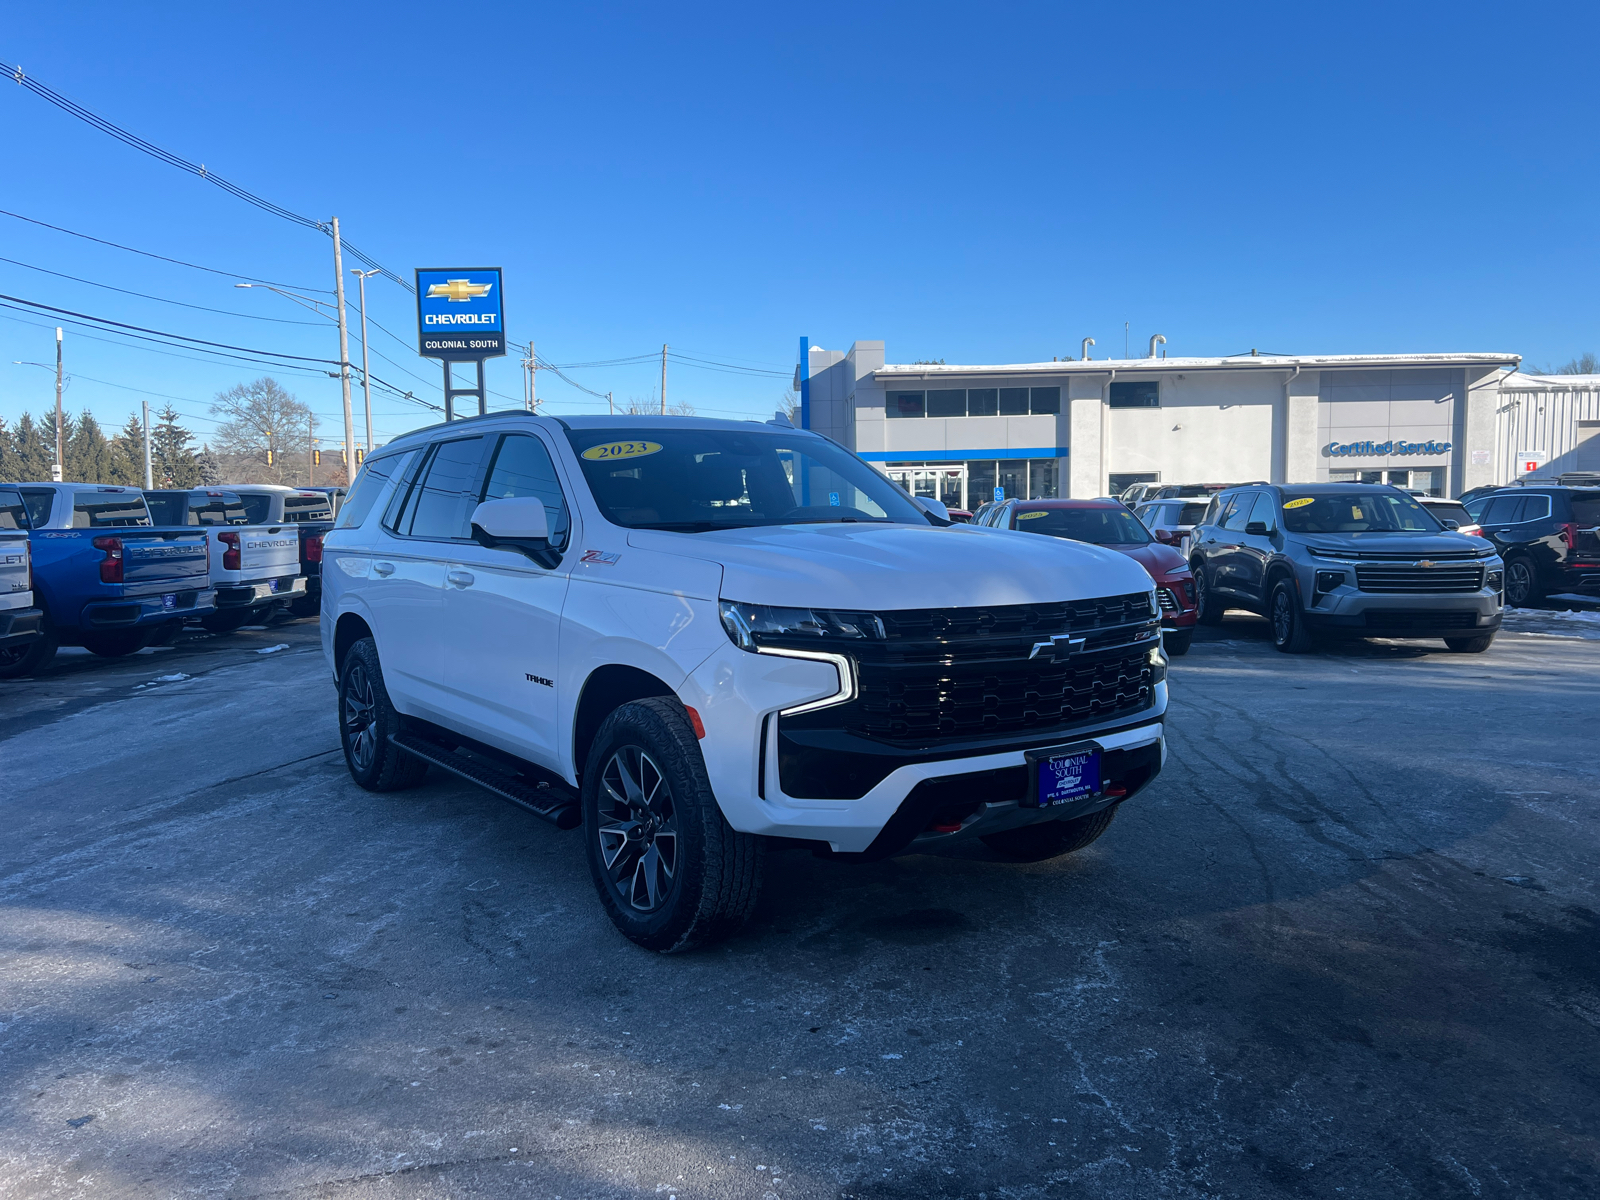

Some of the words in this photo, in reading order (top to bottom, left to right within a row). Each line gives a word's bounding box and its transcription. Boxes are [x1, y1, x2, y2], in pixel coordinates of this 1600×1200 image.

[425, 313, 497, 325] CHEVROLET
[425, 340, 468, 349] COLONIAL
[469, 339, 498, 348] SOUTH
[597, 442, 648, 458] 2023
[1329, 440, 1393, 454] Certified
[1398, 440, 1452, 453] Service
[1288, 498, 1310, 508] 2025
[247, 539, 298, 549] CHEVROLET
[132, 545, 208, 558] CHEVROLET
[525, 672, 554, 688] TAHOE
[1049, 755, 1089, 771] COLONIAL
[1055, 765, 1082, 779] SOUTH
[1058, 778, 1080, 786] CHEVROLET
[1052, 796, 1074, 806] COLONIAL
[1074, 793, 1090, 801] SOUTH
